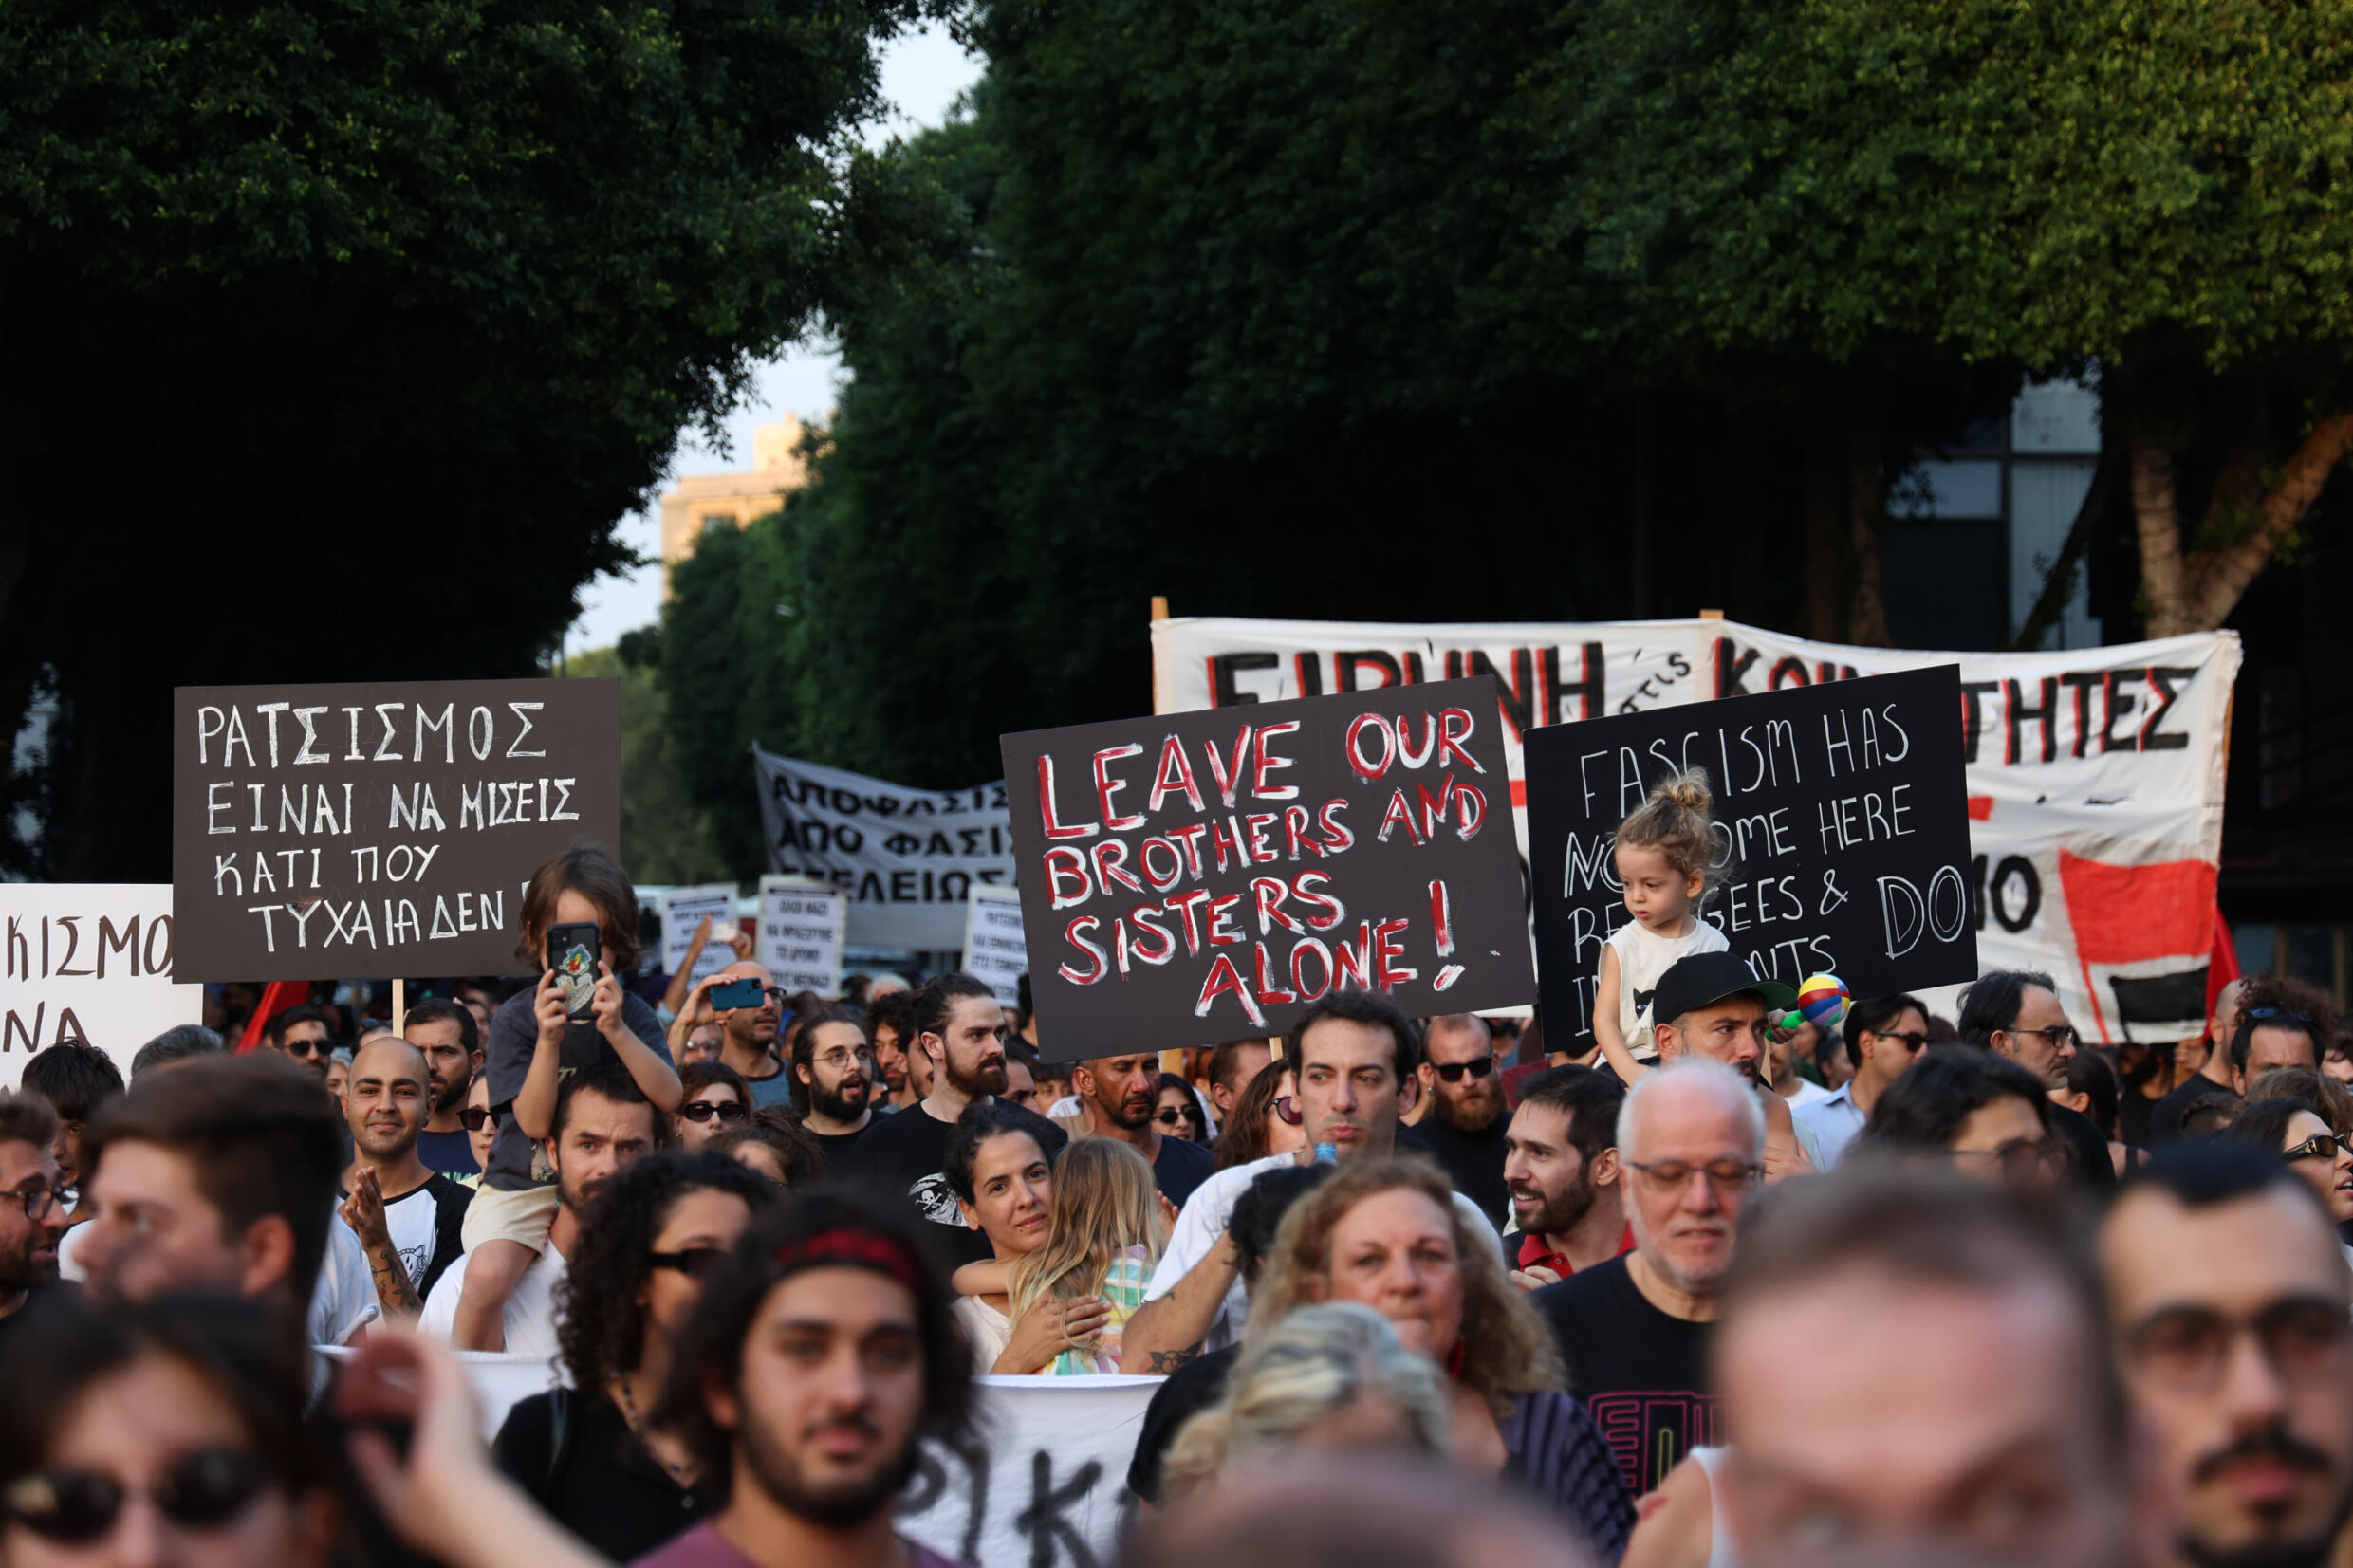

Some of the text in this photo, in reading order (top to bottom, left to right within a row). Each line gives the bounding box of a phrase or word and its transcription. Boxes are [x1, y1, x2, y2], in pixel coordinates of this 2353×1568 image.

[197, 701, 547, 769] ΡΑΤΣΙΣΜΟΣ
[1823, 703, 1910, 778] HAS
[207, 778, 580, 836] ΕΙΝΑΙ ΝΑ ΜΙΣΕΙΣ
[1037, 708, 1487, 839] LEAVE OUR
[778, 818, 1013, 858] ΑΠΟ ΦΑΣΙ
[1043, 771, 1488, 911] BROTHERS AND
[1818, 784, 1917, 855] HERE
[214, 844, 441, 896] ΚΑΤΙ ΠΟΥ
[1819, 868, 1849, 916] &
[7, 912, 174, 983] ΚΙΣΜΟ
[1058, 869, 1346, 986] SISTERS
[1876, 864, 1967, 961] DO
